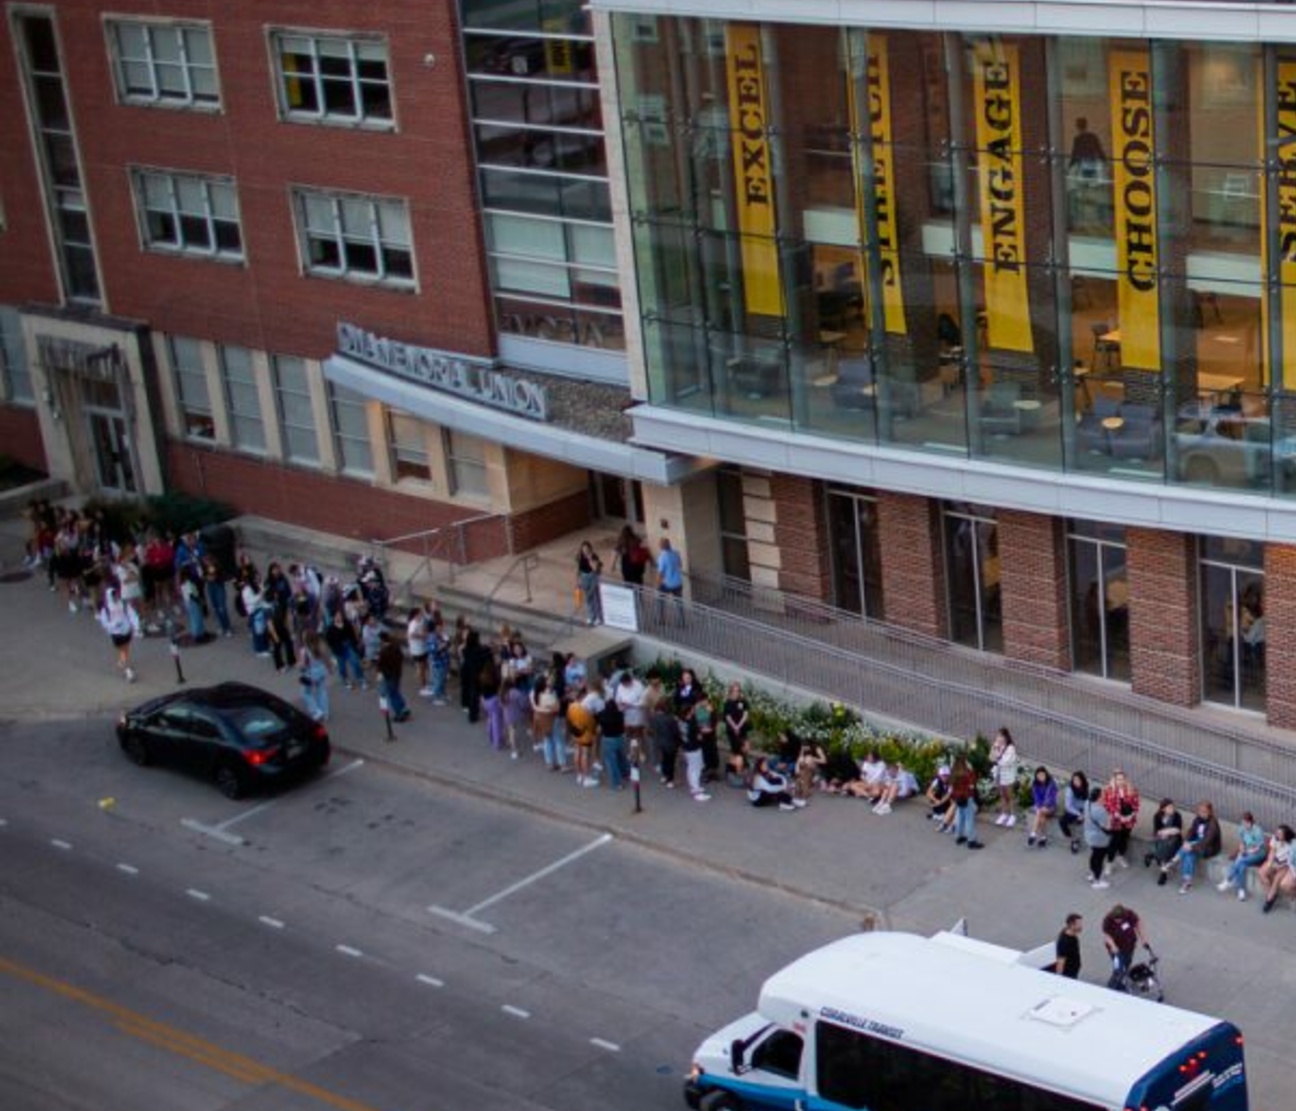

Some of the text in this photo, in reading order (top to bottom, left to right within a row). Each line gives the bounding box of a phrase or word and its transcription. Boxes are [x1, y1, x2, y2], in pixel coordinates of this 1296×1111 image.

[736, 46, 767, 207] EXCEL
[984, 61, 1020, 276] ENGAGE
[1121, 71, 1156, 292] CHOOSE
